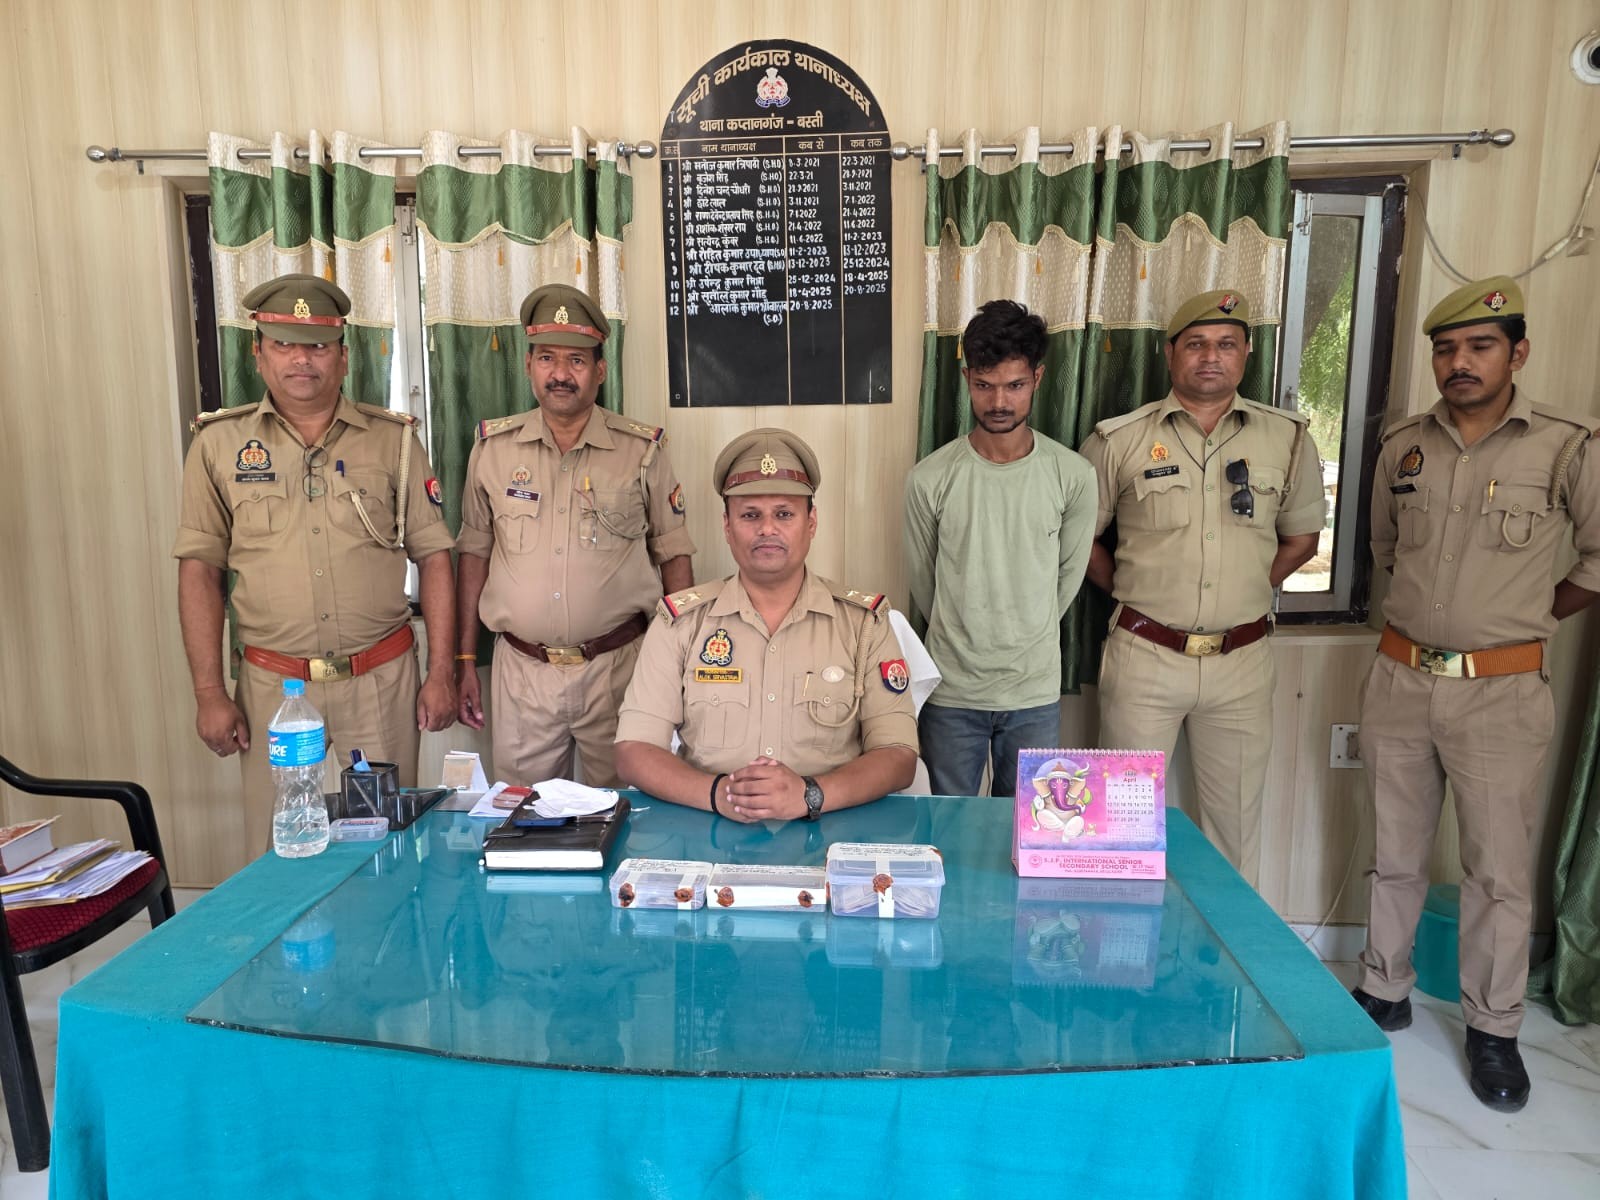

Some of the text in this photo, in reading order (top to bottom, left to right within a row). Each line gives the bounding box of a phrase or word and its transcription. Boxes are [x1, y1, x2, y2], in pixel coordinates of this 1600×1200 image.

[676, 47, 871, 123] सूची कार्यकाल थानाध्यक्ष
[699, 120, 724, 132] थाना
[726, 113, 784, 131] कप्तानगंज
[797, 110, 823, 128] बस्ती
[701, 144, 718, 152] नाम
[720, 143, 757, 152] थानाध्यक्ष
[798, 141, 813, 150] कब
[816, 137, 824, 150] से
[850, 139, 865, 148] कब
[867, 138, 883, 147] तक
[668, 162, 673, 172] 1
[682, 159, 692, 172] श्री
[668, 175, 674, 184] 2
[682, 172, 692, 184] श्री
[668, 187, 674, 196] 3
[683, 184, 693, 196] श्री
[667, 200, 674, 208] 4
[683, 196, 692, 208] श्री
[669, 212, 676, 221] 5
[683, 209, 692, 221] श्री
[669, 225, 675, 234] 6
[685, 222, 694, 235] श्री
[669, 238, 676, 248] 7
[685, 235, 695, 247] श्री
[685, 248, 698, 261] श्री
[671, 266, 678, 276] 9
[688, 262, 703, 276] श्री
[670, 280, 680, 290] 10
[670, 292, 679, 303] 11
[687, 289, 700, 303] श्री
[669, 305, 680, 316] 12
[687, 302, 699, 316] श्री
